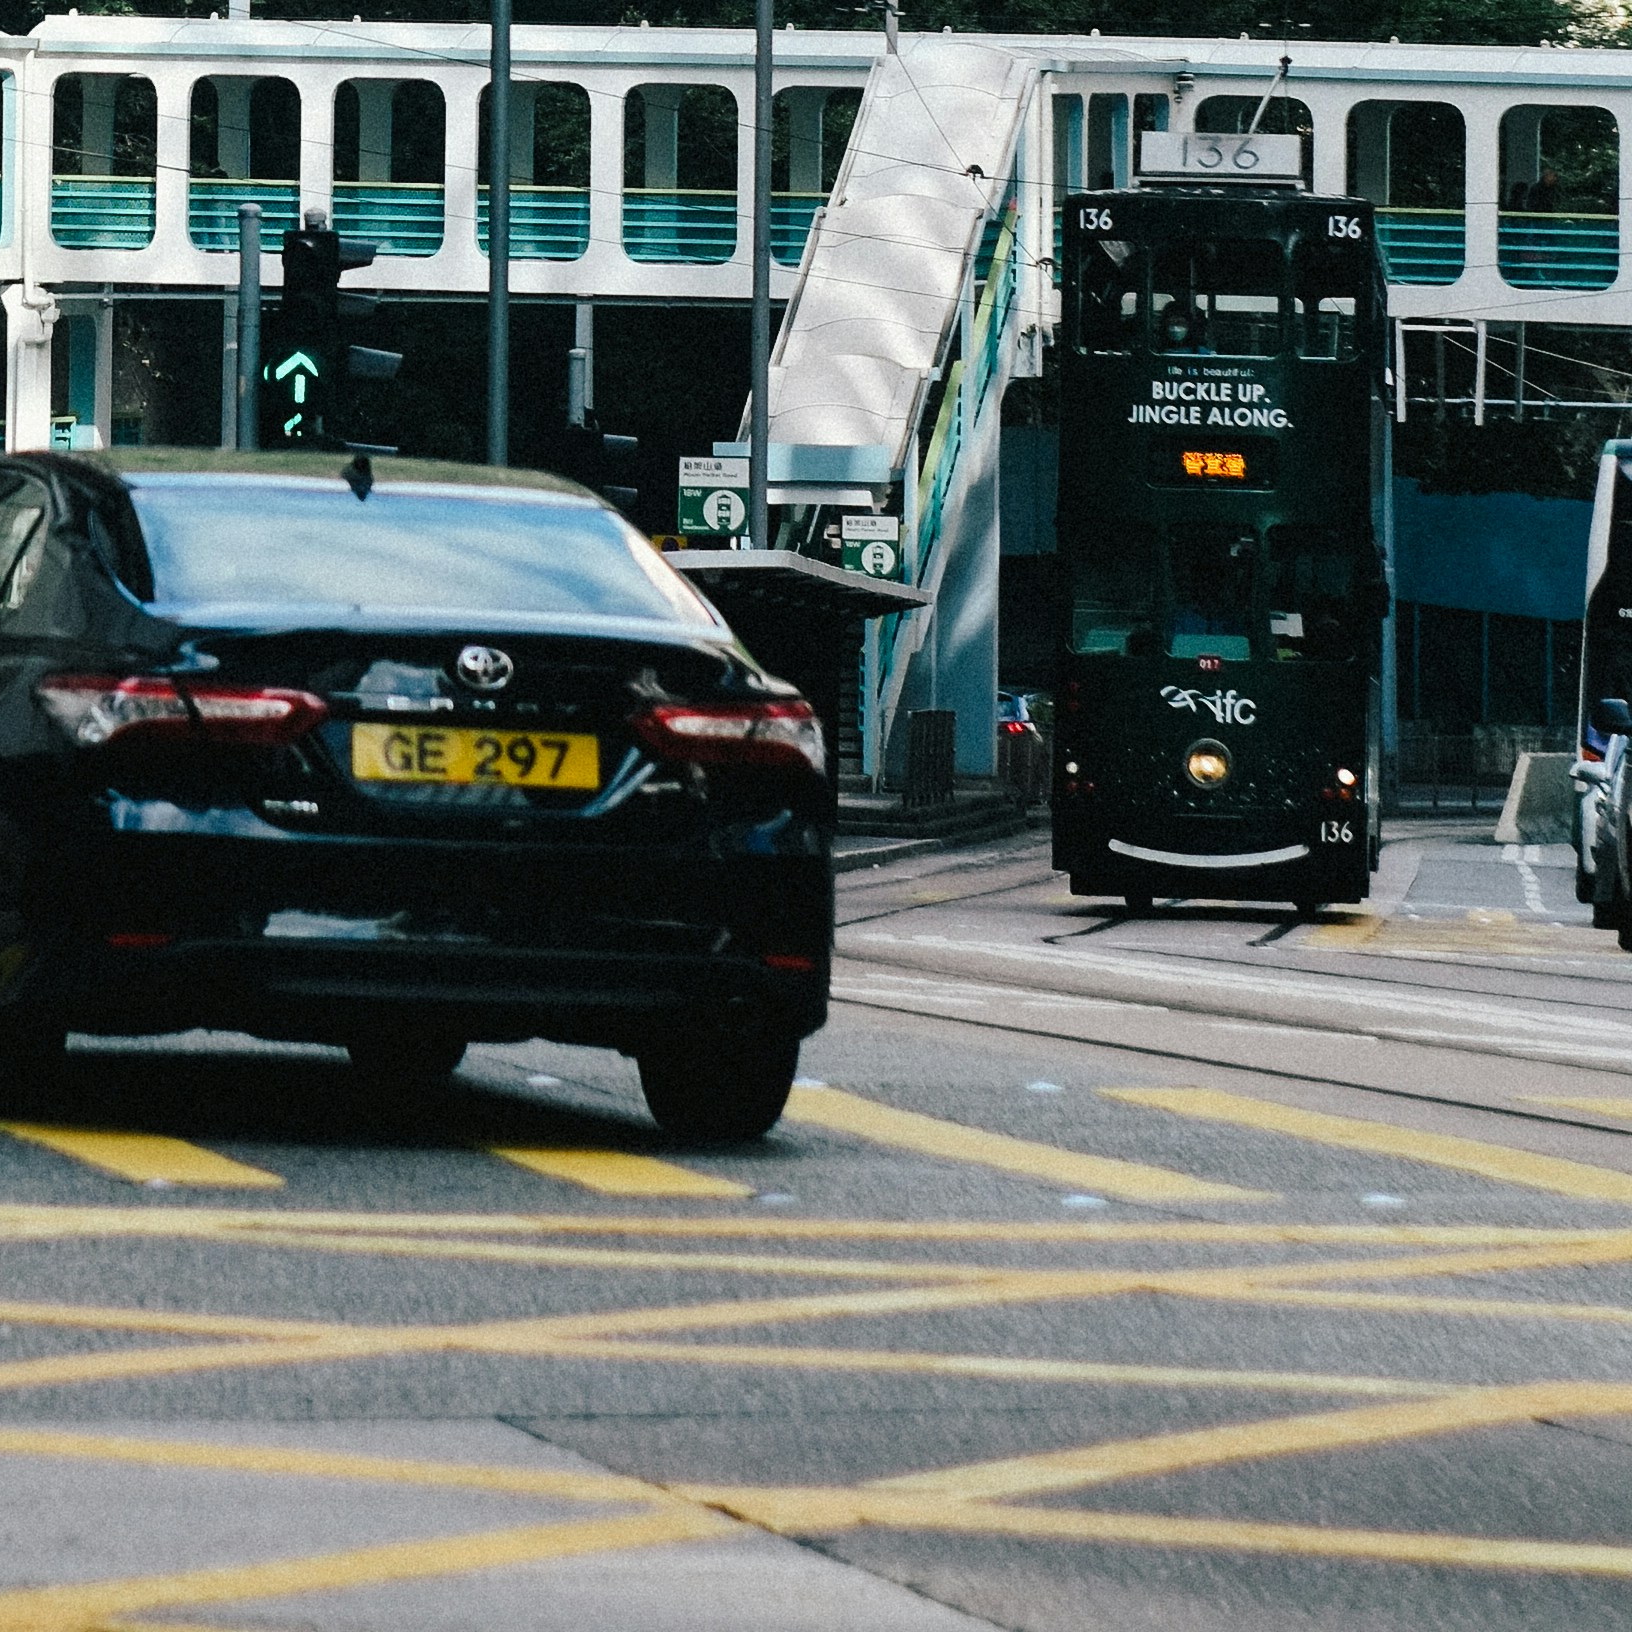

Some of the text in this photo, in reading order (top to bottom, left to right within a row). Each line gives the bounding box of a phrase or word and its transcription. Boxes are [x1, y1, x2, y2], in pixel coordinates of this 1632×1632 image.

[1181, 135, 1260, 170] 136
[1079, 208, 1113, 230] 136
[1328, 216, 1362, 239] 136
[1151, 380, 1272, 404] BUCKLE UP.
[1127, 404, 1294, 428] JINGLE ALONG.
[382, 730, 571, 781] GE 297
[1321, 821, 1353, 843] 136
